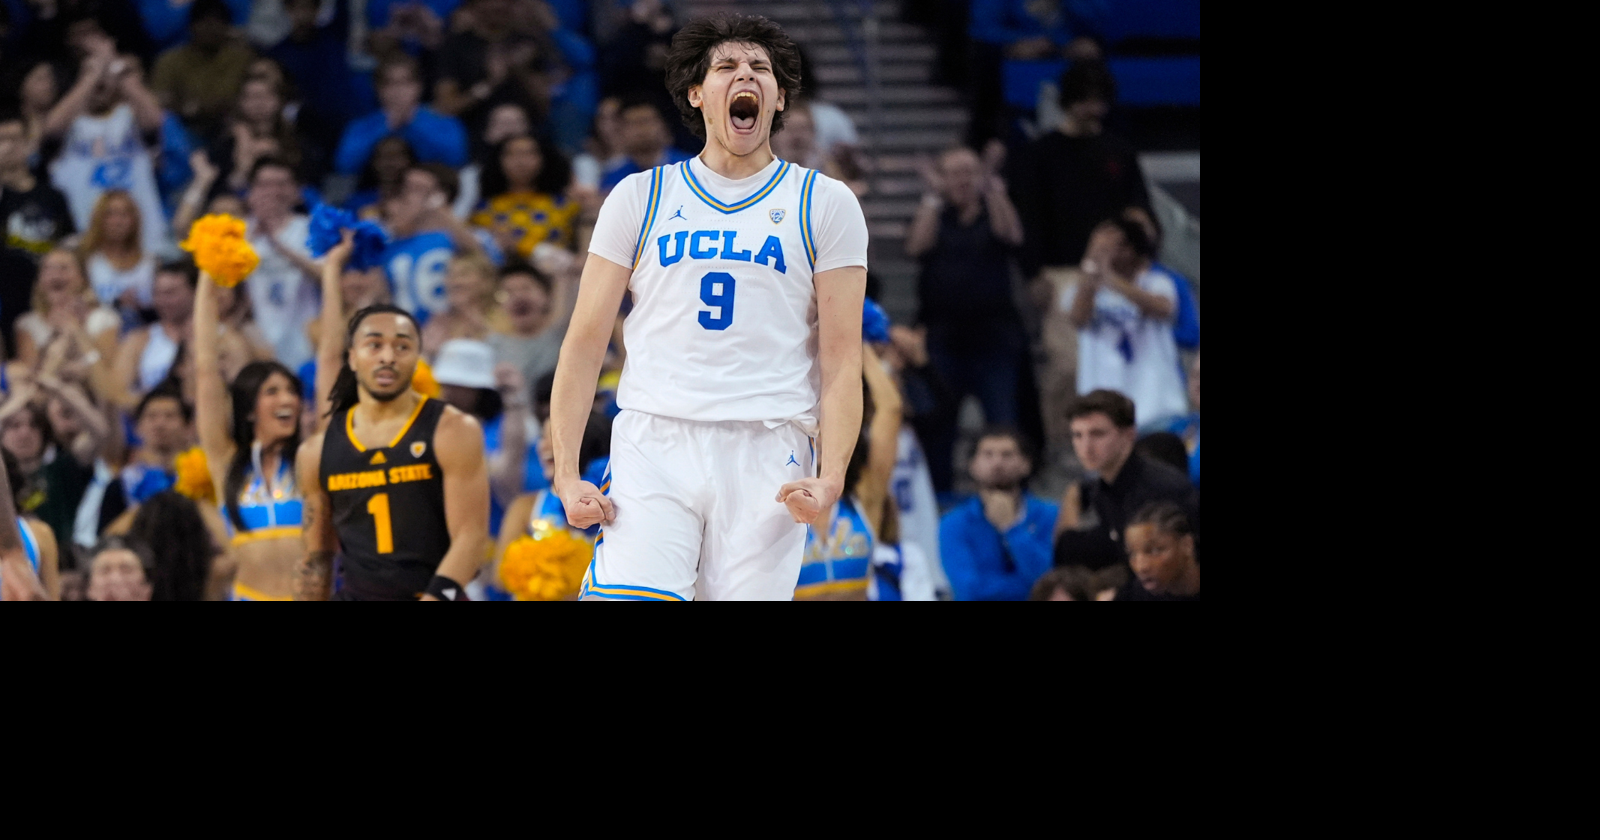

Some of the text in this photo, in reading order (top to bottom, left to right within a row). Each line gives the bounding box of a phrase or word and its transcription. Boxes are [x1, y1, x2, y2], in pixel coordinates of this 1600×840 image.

[658, 230, 787, 274] UCLA
[698, 272, 736, 331] 9
[328, 463, 433, 492] ARIZONA STATE
[367, 493, 394, 554] 1
